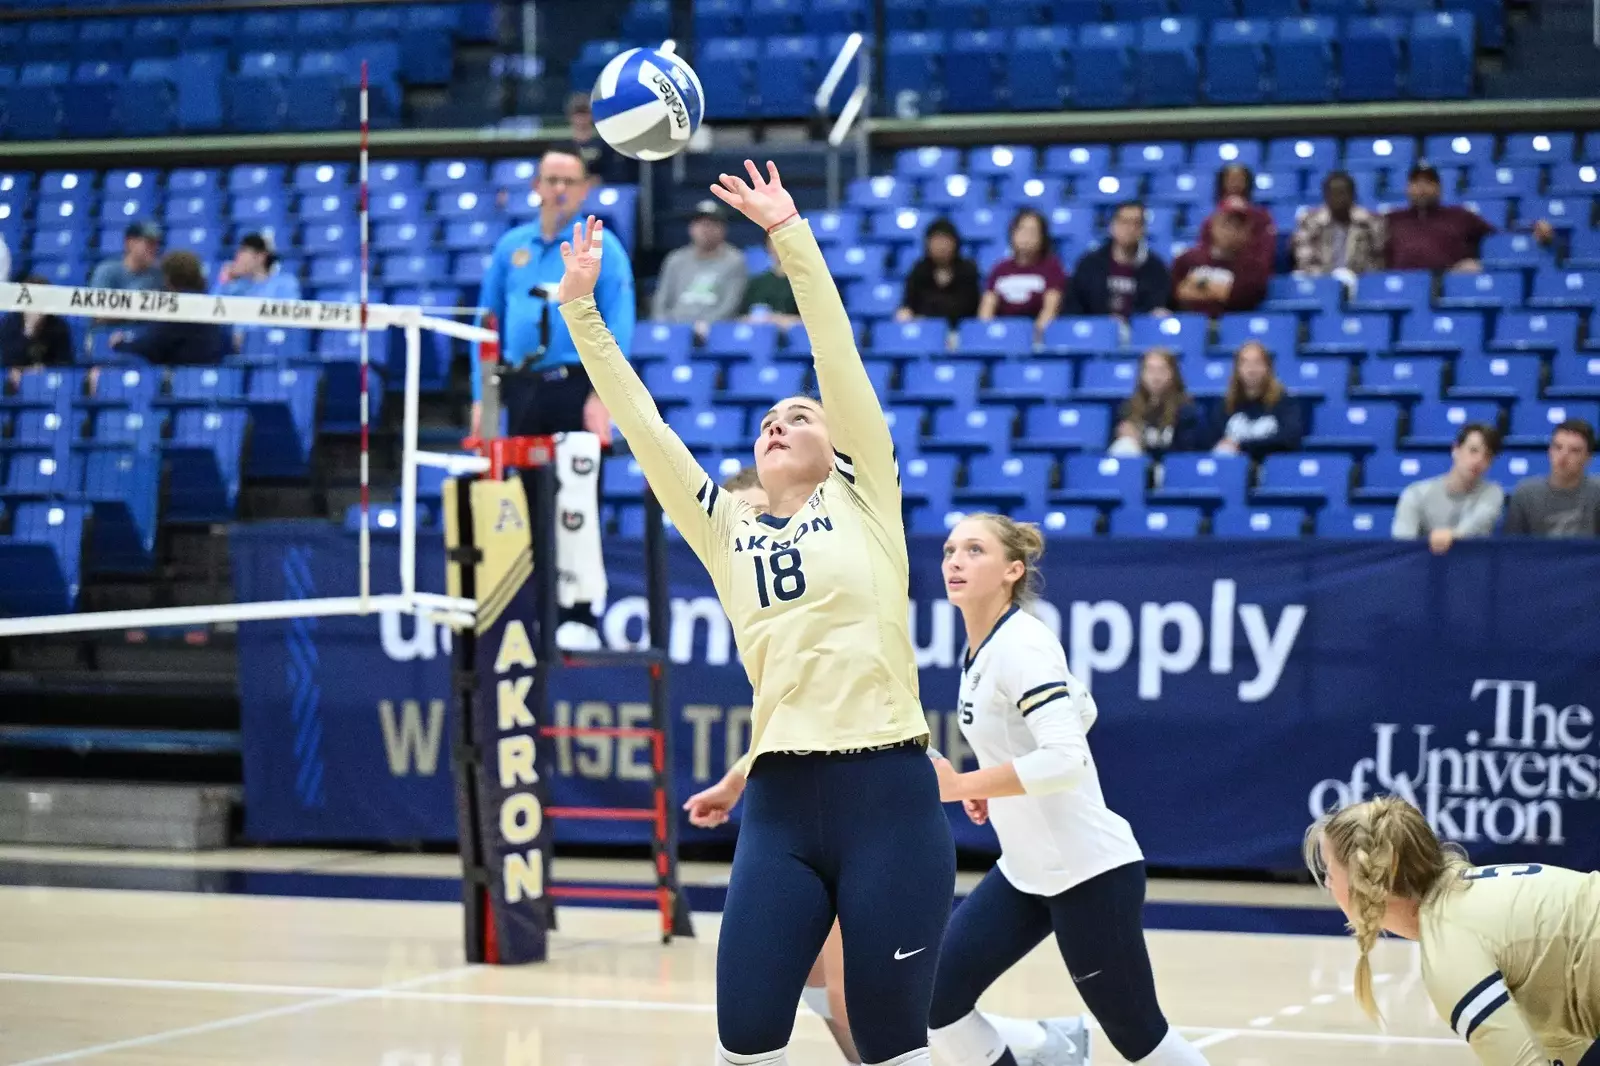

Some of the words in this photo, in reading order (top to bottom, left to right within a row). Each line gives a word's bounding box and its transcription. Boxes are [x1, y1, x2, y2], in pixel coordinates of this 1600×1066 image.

[652, 73, 689, 129] molten
[70, 288, 132, 310] AKRON
[139, 291, 180, 313] ZIPS
[258, 301, 312, 320] AKRON
[318, 303, 353, 323] ZIPS
[752, 547, 807, 609] 18
[555, 701, 652, 781] ISE
[1470, 678, 1594, 750] The
[494, 618, 546, 904] AKRON
[1308, 757, 1376, 822] of
[1371, 722, 1600, 799] Univers
